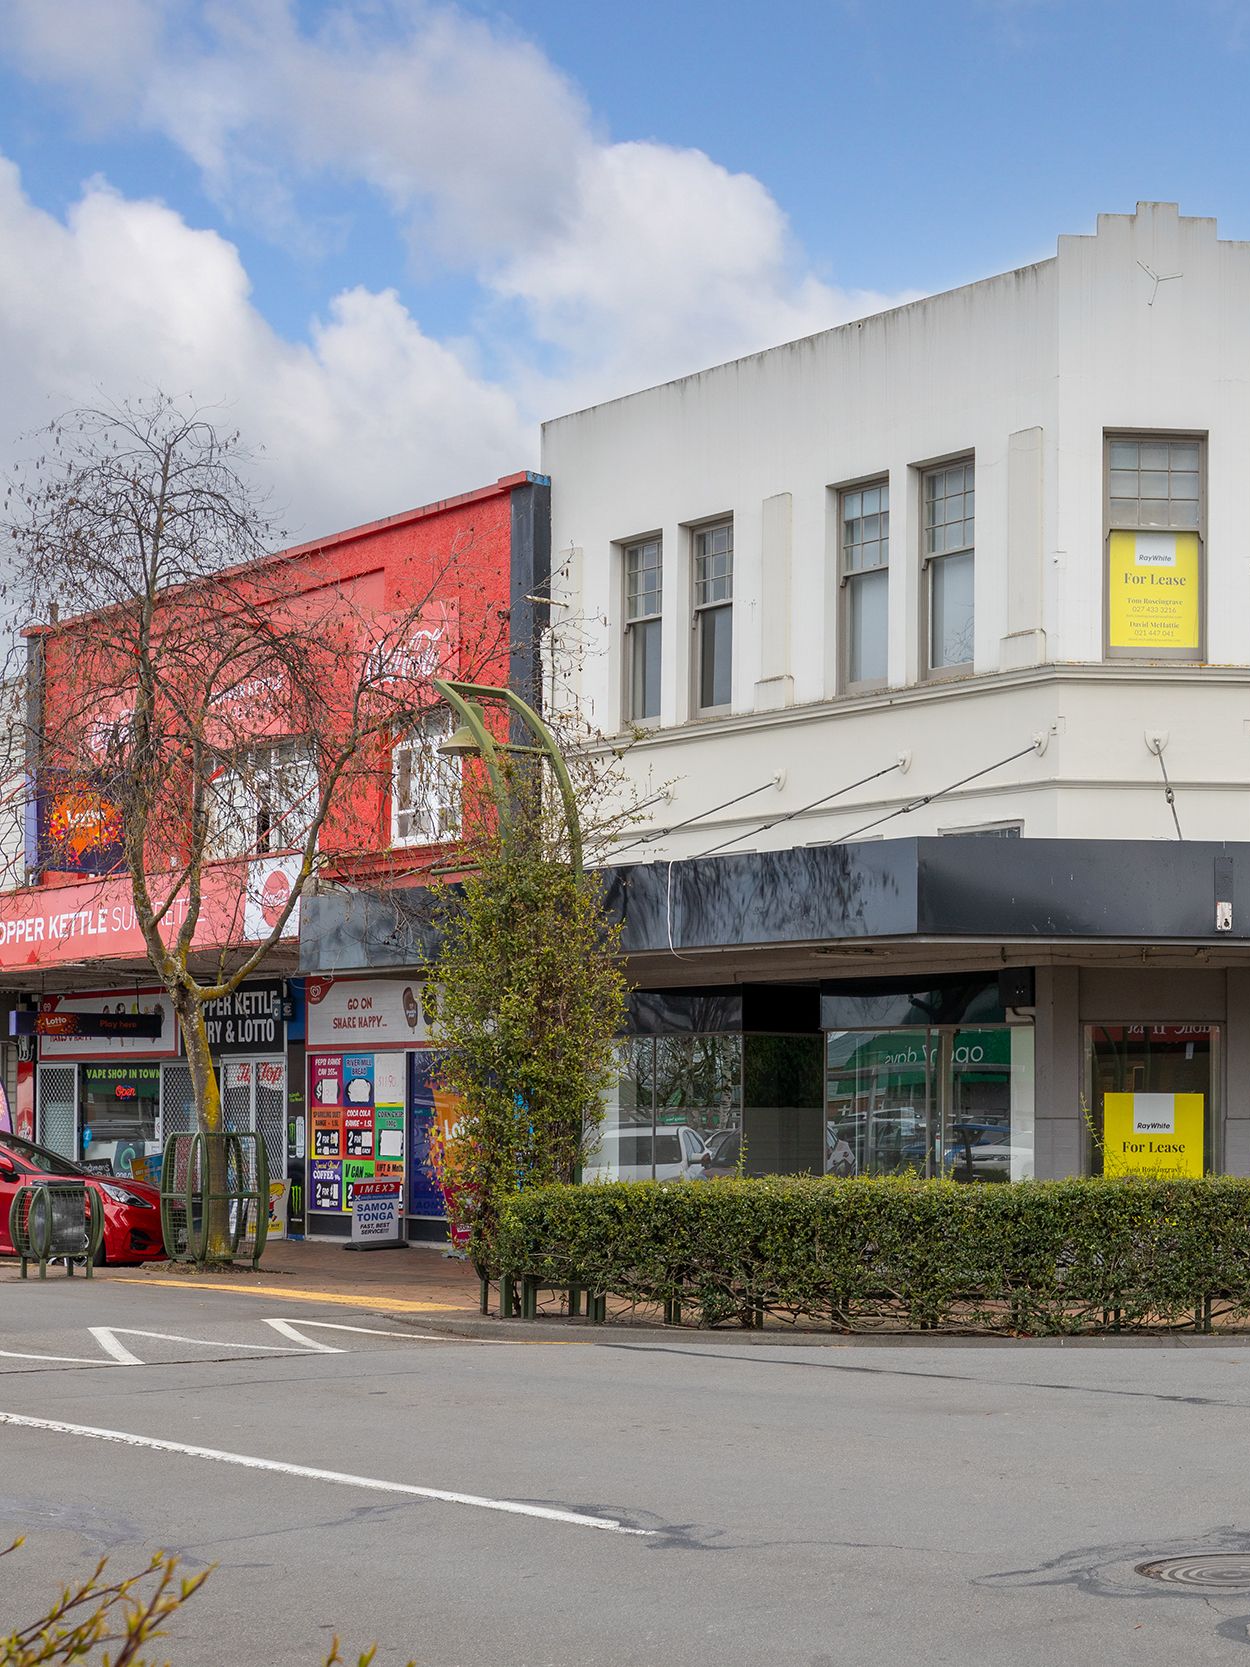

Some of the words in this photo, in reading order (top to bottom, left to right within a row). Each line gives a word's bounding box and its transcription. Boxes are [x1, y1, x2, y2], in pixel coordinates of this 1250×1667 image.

[1138, 554, 1172, 562] RayWhite
[1124, 572, 1147, 584] For
[1150, 573, 1187, 586] Lease
[48, 908, 108, 939] KETTLE
[347, 998, 359, 1010] GO
[361, 997, 373, 1009] ON
[45, 1016, 67, 1025] Lotto
[333, 1017, 356, 1029] SHARE
[225, 1020, 235, 1043] &
[238, 1018, 275, 1042] LOTTO
[86, 1069, 106, 1080] VAPE
[108, 1069, 128, 1079] SHOP
[129, 1069, 137, 1079] IN
[115, 1084, 136, 1099] Open
[1136, 1122, 1171, 1131] RayWhite
[316, 1131, 322, 1147] 2
[321, 1135, 329, 1144] FOR
[348, 1131, 354, 1147] 2
[1122, 1141, 1146, 1153] For
[1149, 1141, 1186, 1153] Lease
[313, 1170, 334, 1180] COFFEE
[351, 1165, 364, 1178] CAN
[316, 1183, 322, 1199] 2
[321, 1187, 329, 1196] FOR
[360, 1184, 388, 1194] IMEX
[357, 1202, 394, 1212] SAMOA
[357, 1212, 394, 1221] TONGA
